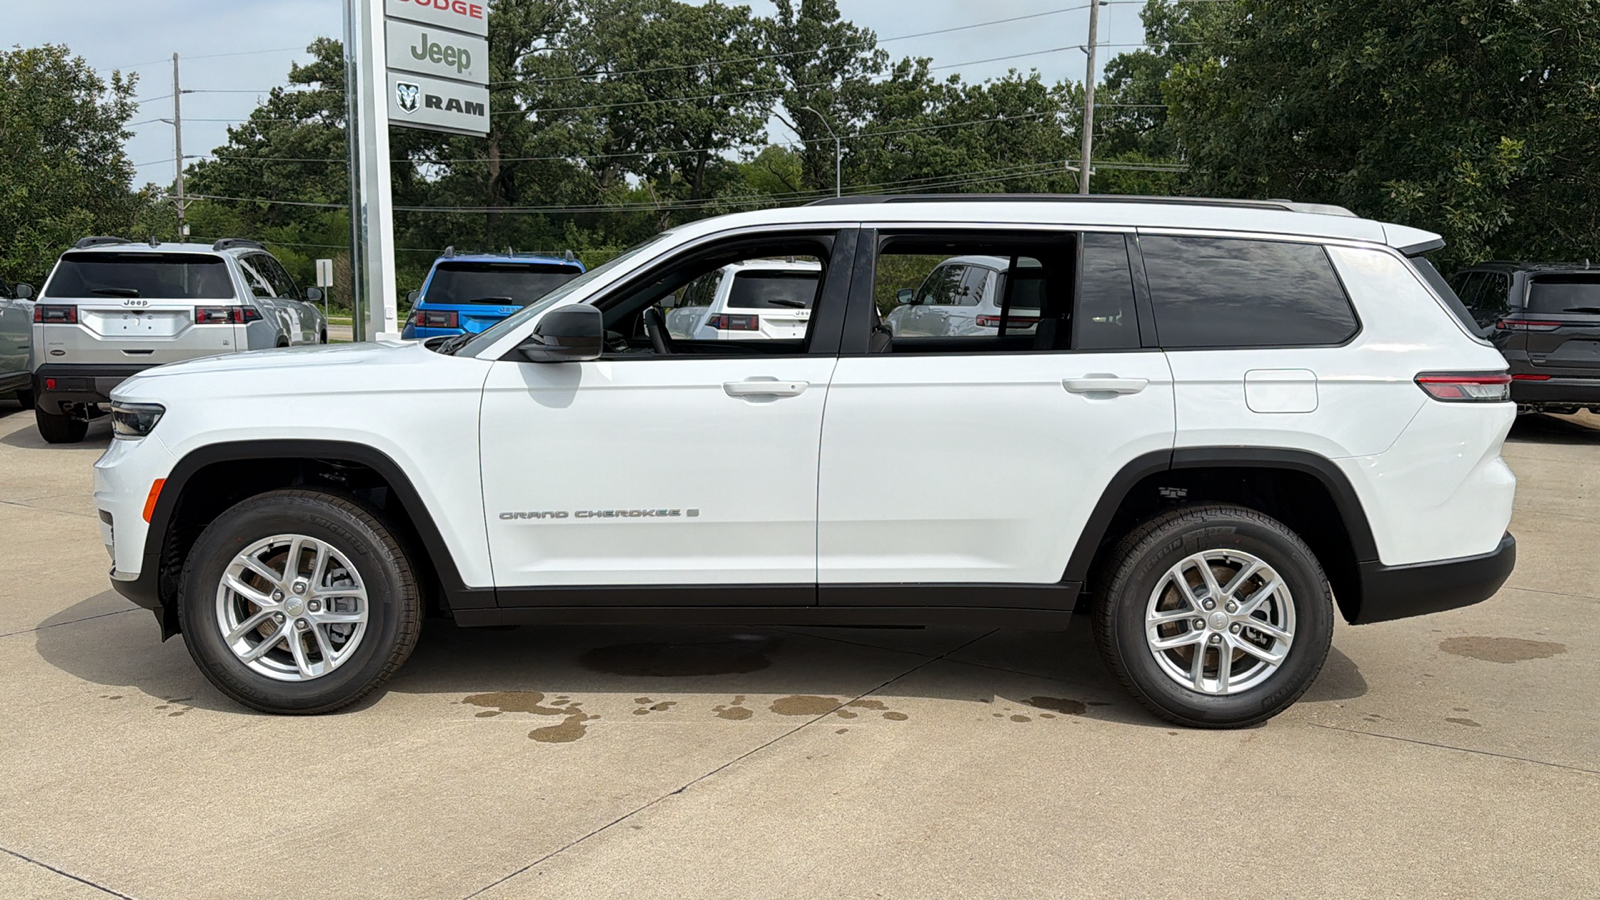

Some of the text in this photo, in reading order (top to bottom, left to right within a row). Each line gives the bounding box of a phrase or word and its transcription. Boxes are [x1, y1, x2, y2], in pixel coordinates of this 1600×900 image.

[410, 33, 472, 74] Jeep
[425, 94, 485, 117] RAM
[123, 299, 148, 307] Jeep
[499, 510, 569, 520] GRAND
[574, 509, 682, 519] CHEROKEE
